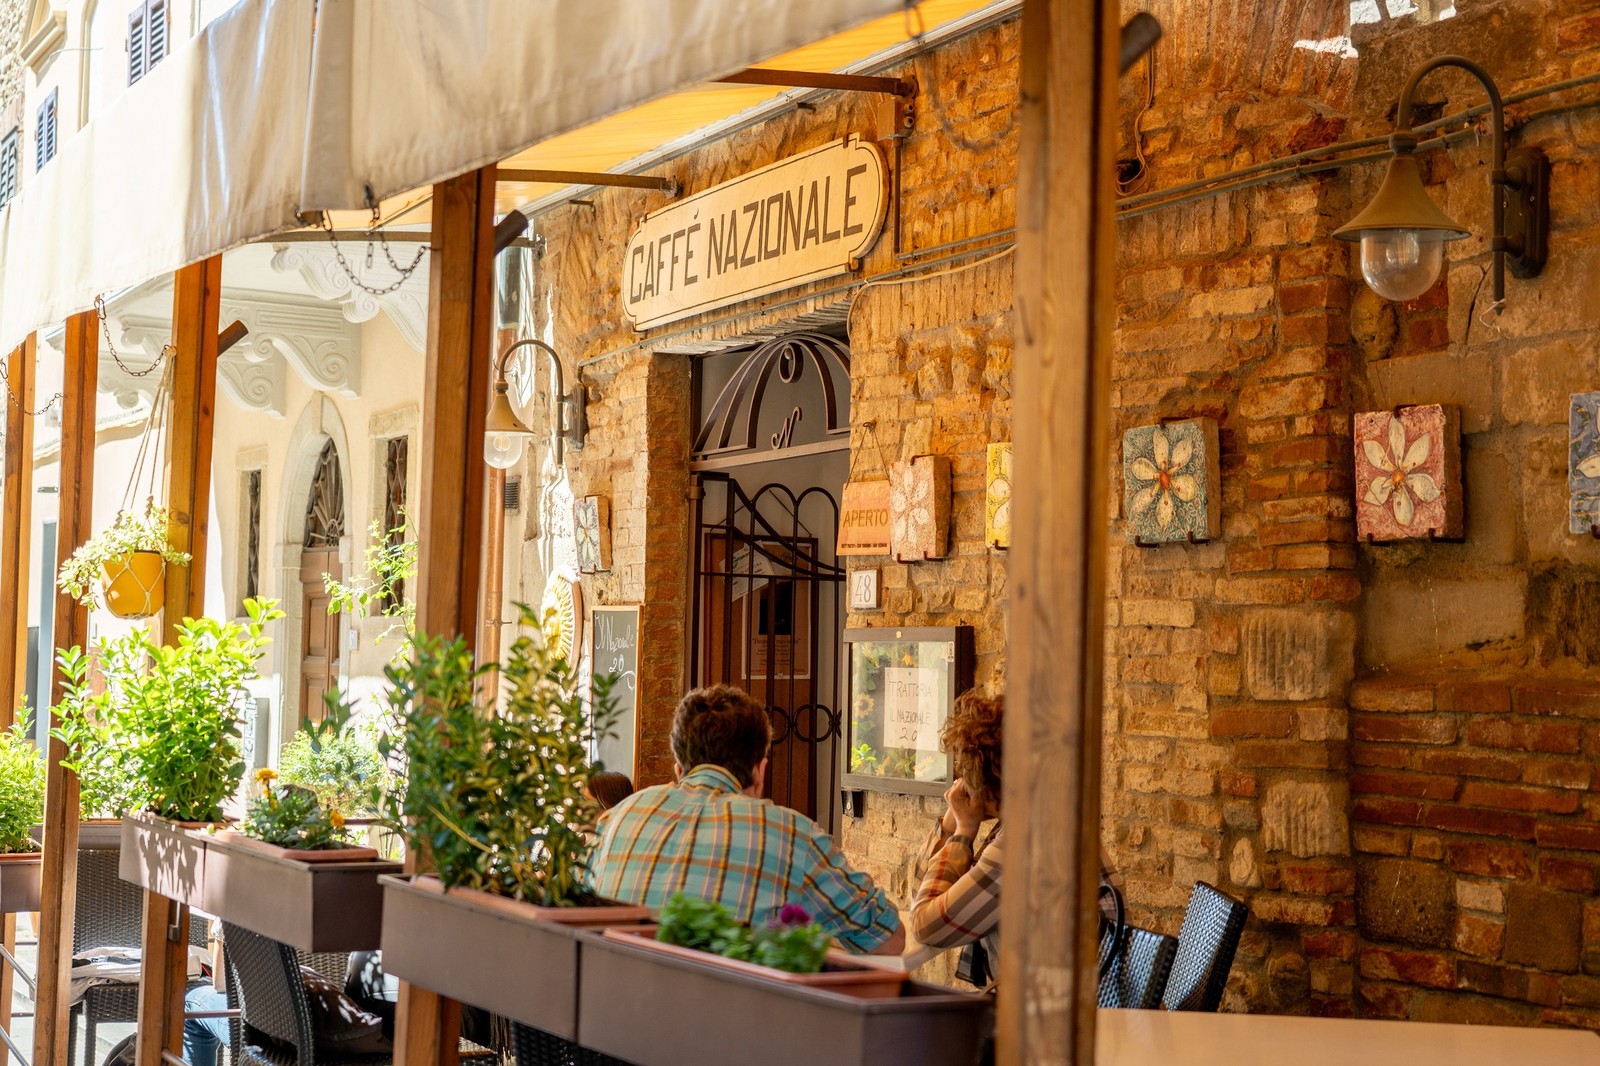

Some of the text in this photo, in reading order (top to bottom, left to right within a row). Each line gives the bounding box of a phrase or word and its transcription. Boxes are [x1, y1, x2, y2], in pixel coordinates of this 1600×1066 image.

[629, 163, 868, 305] CAFFÉ NAZIONALE
[842, 508, 889, 528] APERTO
[855, 574, 872, 603] 48
[896, 709, 931, 726] NAZIONALE
